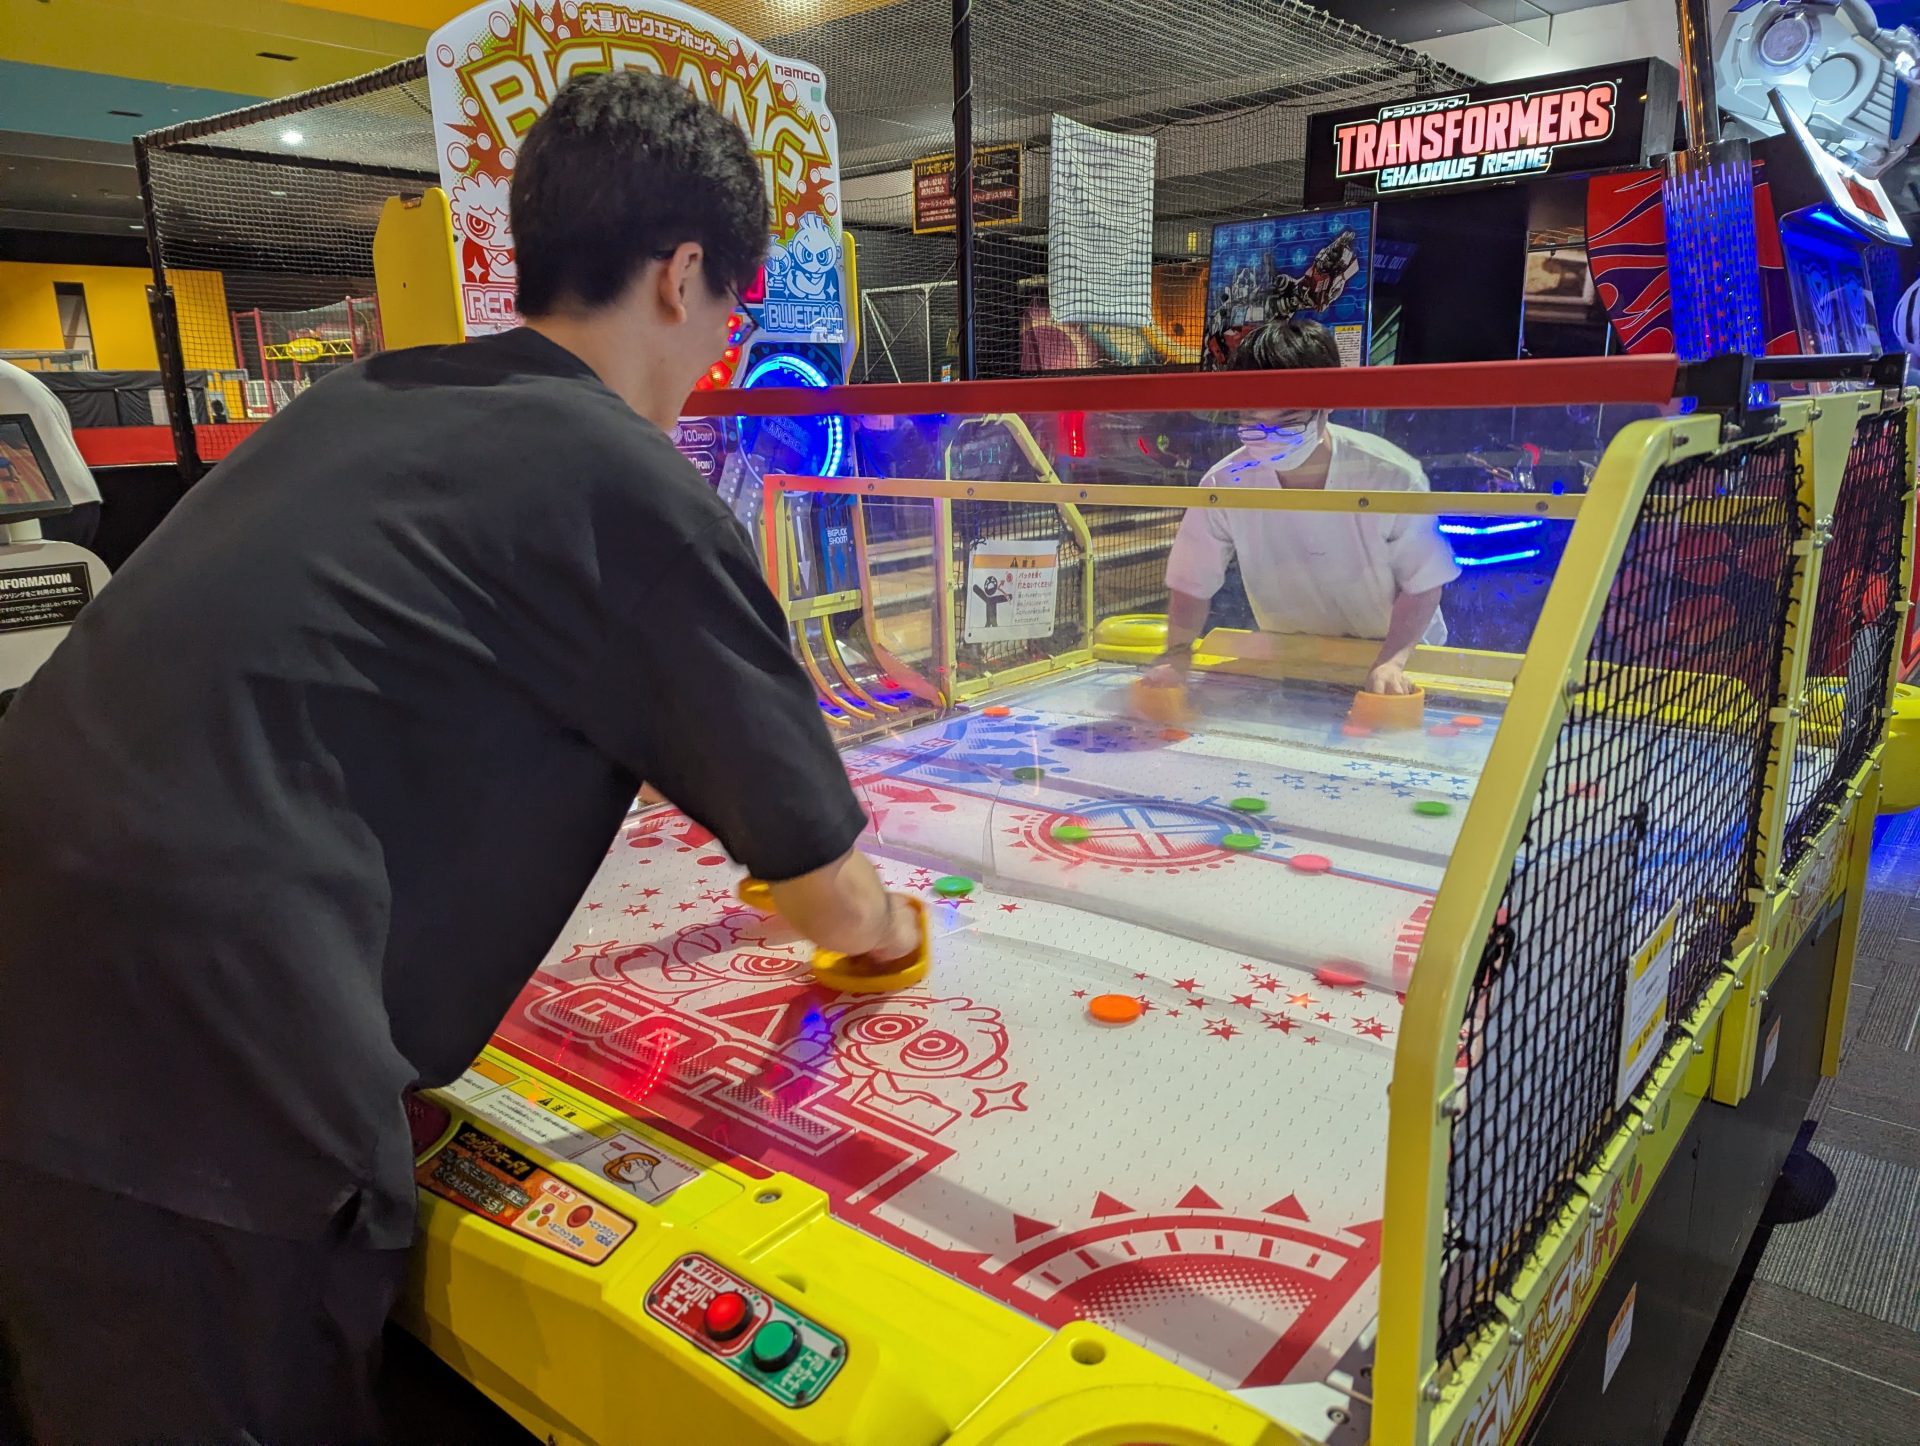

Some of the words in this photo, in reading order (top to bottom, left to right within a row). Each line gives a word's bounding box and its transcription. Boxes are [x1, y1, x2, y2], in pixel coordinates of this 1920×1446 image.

[582, 8, 729, 61] 大量パックエアホッケー
[775, 64, 820, 84] namco
[1339, 86, 1612, 172] TRANSFORMERS
[1381, 157, 1477, 188] SHADOWS
[1481, 149, 1549, 175] RISING
[661, 1290, 693, 1317] モード
